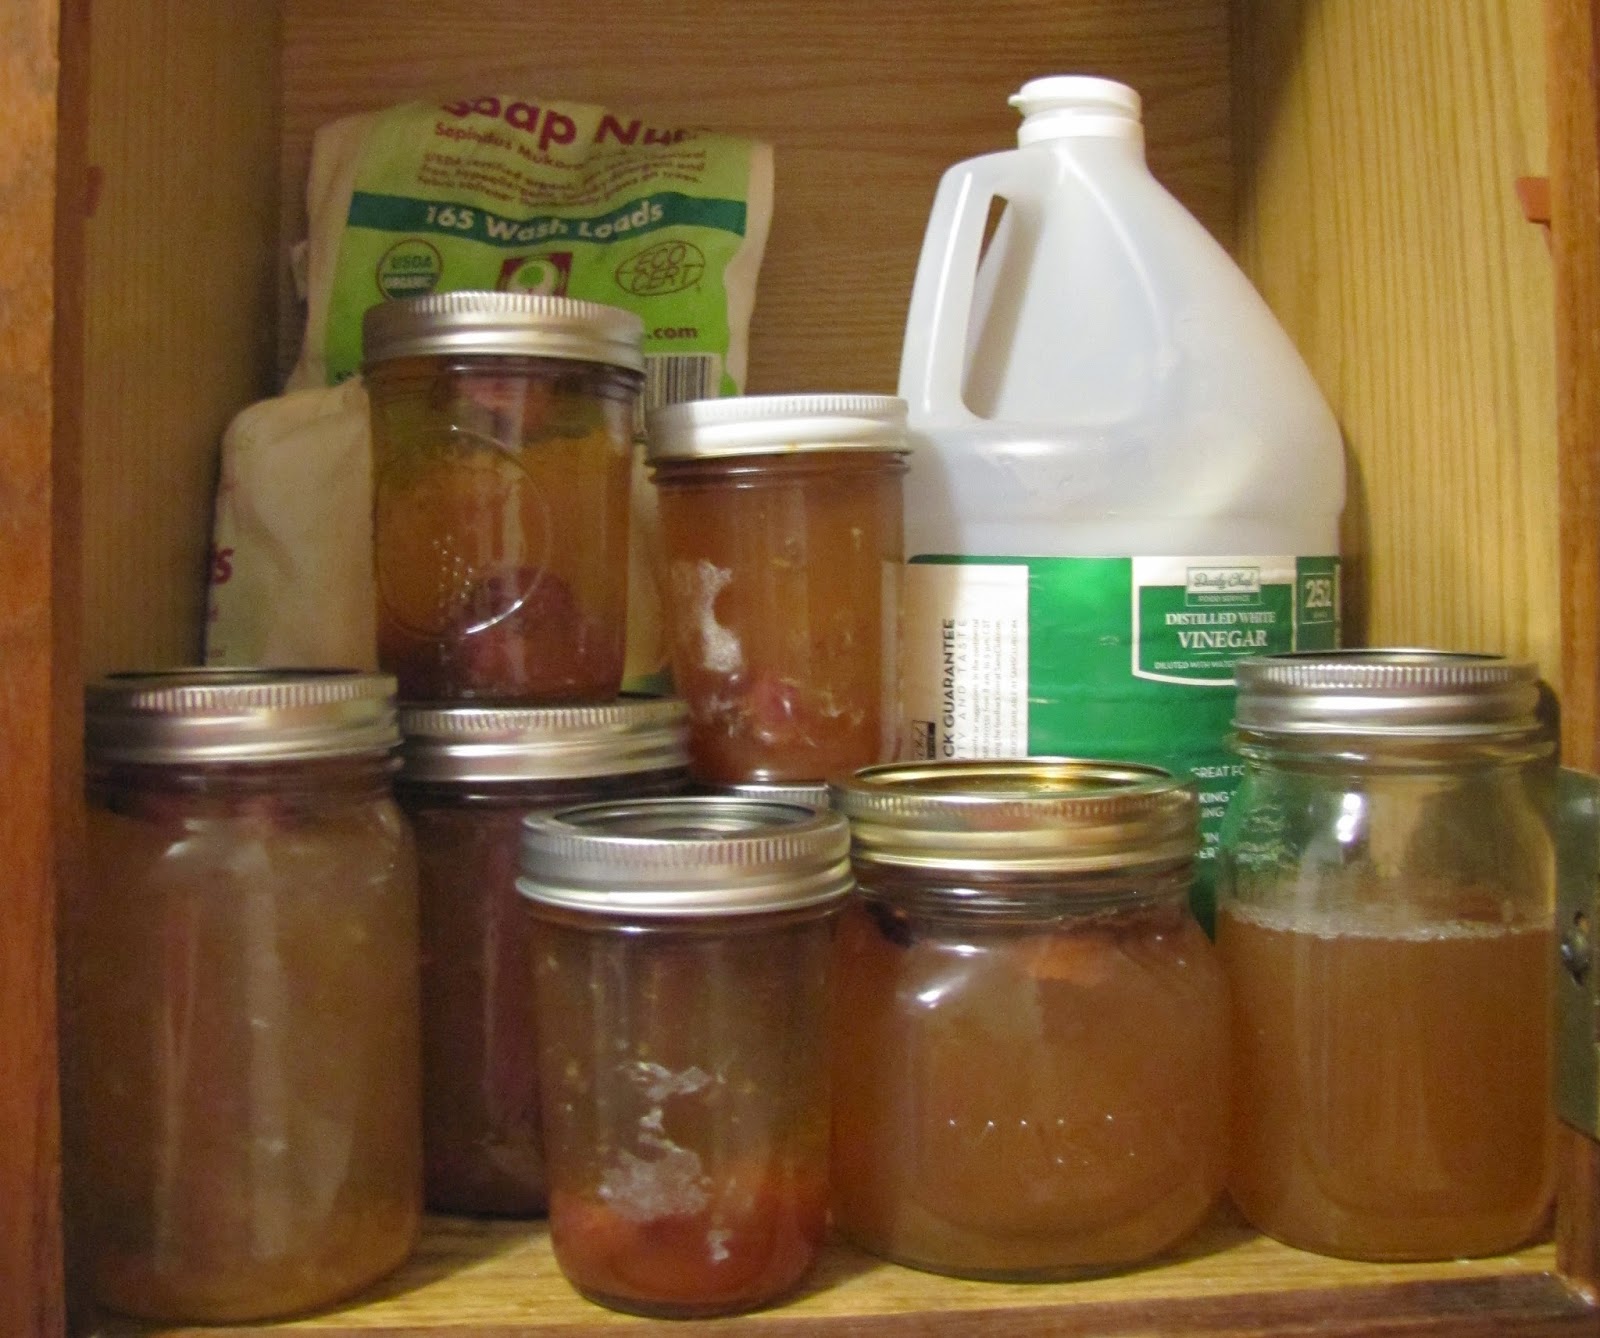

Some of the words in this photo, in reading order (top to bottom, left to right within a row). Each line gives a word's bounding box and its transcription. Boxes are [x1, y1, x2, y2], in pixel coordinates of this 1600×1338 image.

[594, 114, 690, 146] Nu
[426, 205, 474, 230] 165
[485, 215, 569, 242] Wash
[578, 201, 664, 239] Loads
[1165, 612, 1237, 625] DISTILLED
[1239, 611, 1276, 624] WHITE
[957, 618, 967, 673] TASTE
[1178, 630, 1268, 649] VINEGAR
[942, 617, 955, 729] GUARANTEE
[1155, 661, 1190, 670] DILUTED
[1191, 660, 1211, 669] WITH
[1212, 660, 1236, 669] WATE
[957, 685, 967, 720] AND
